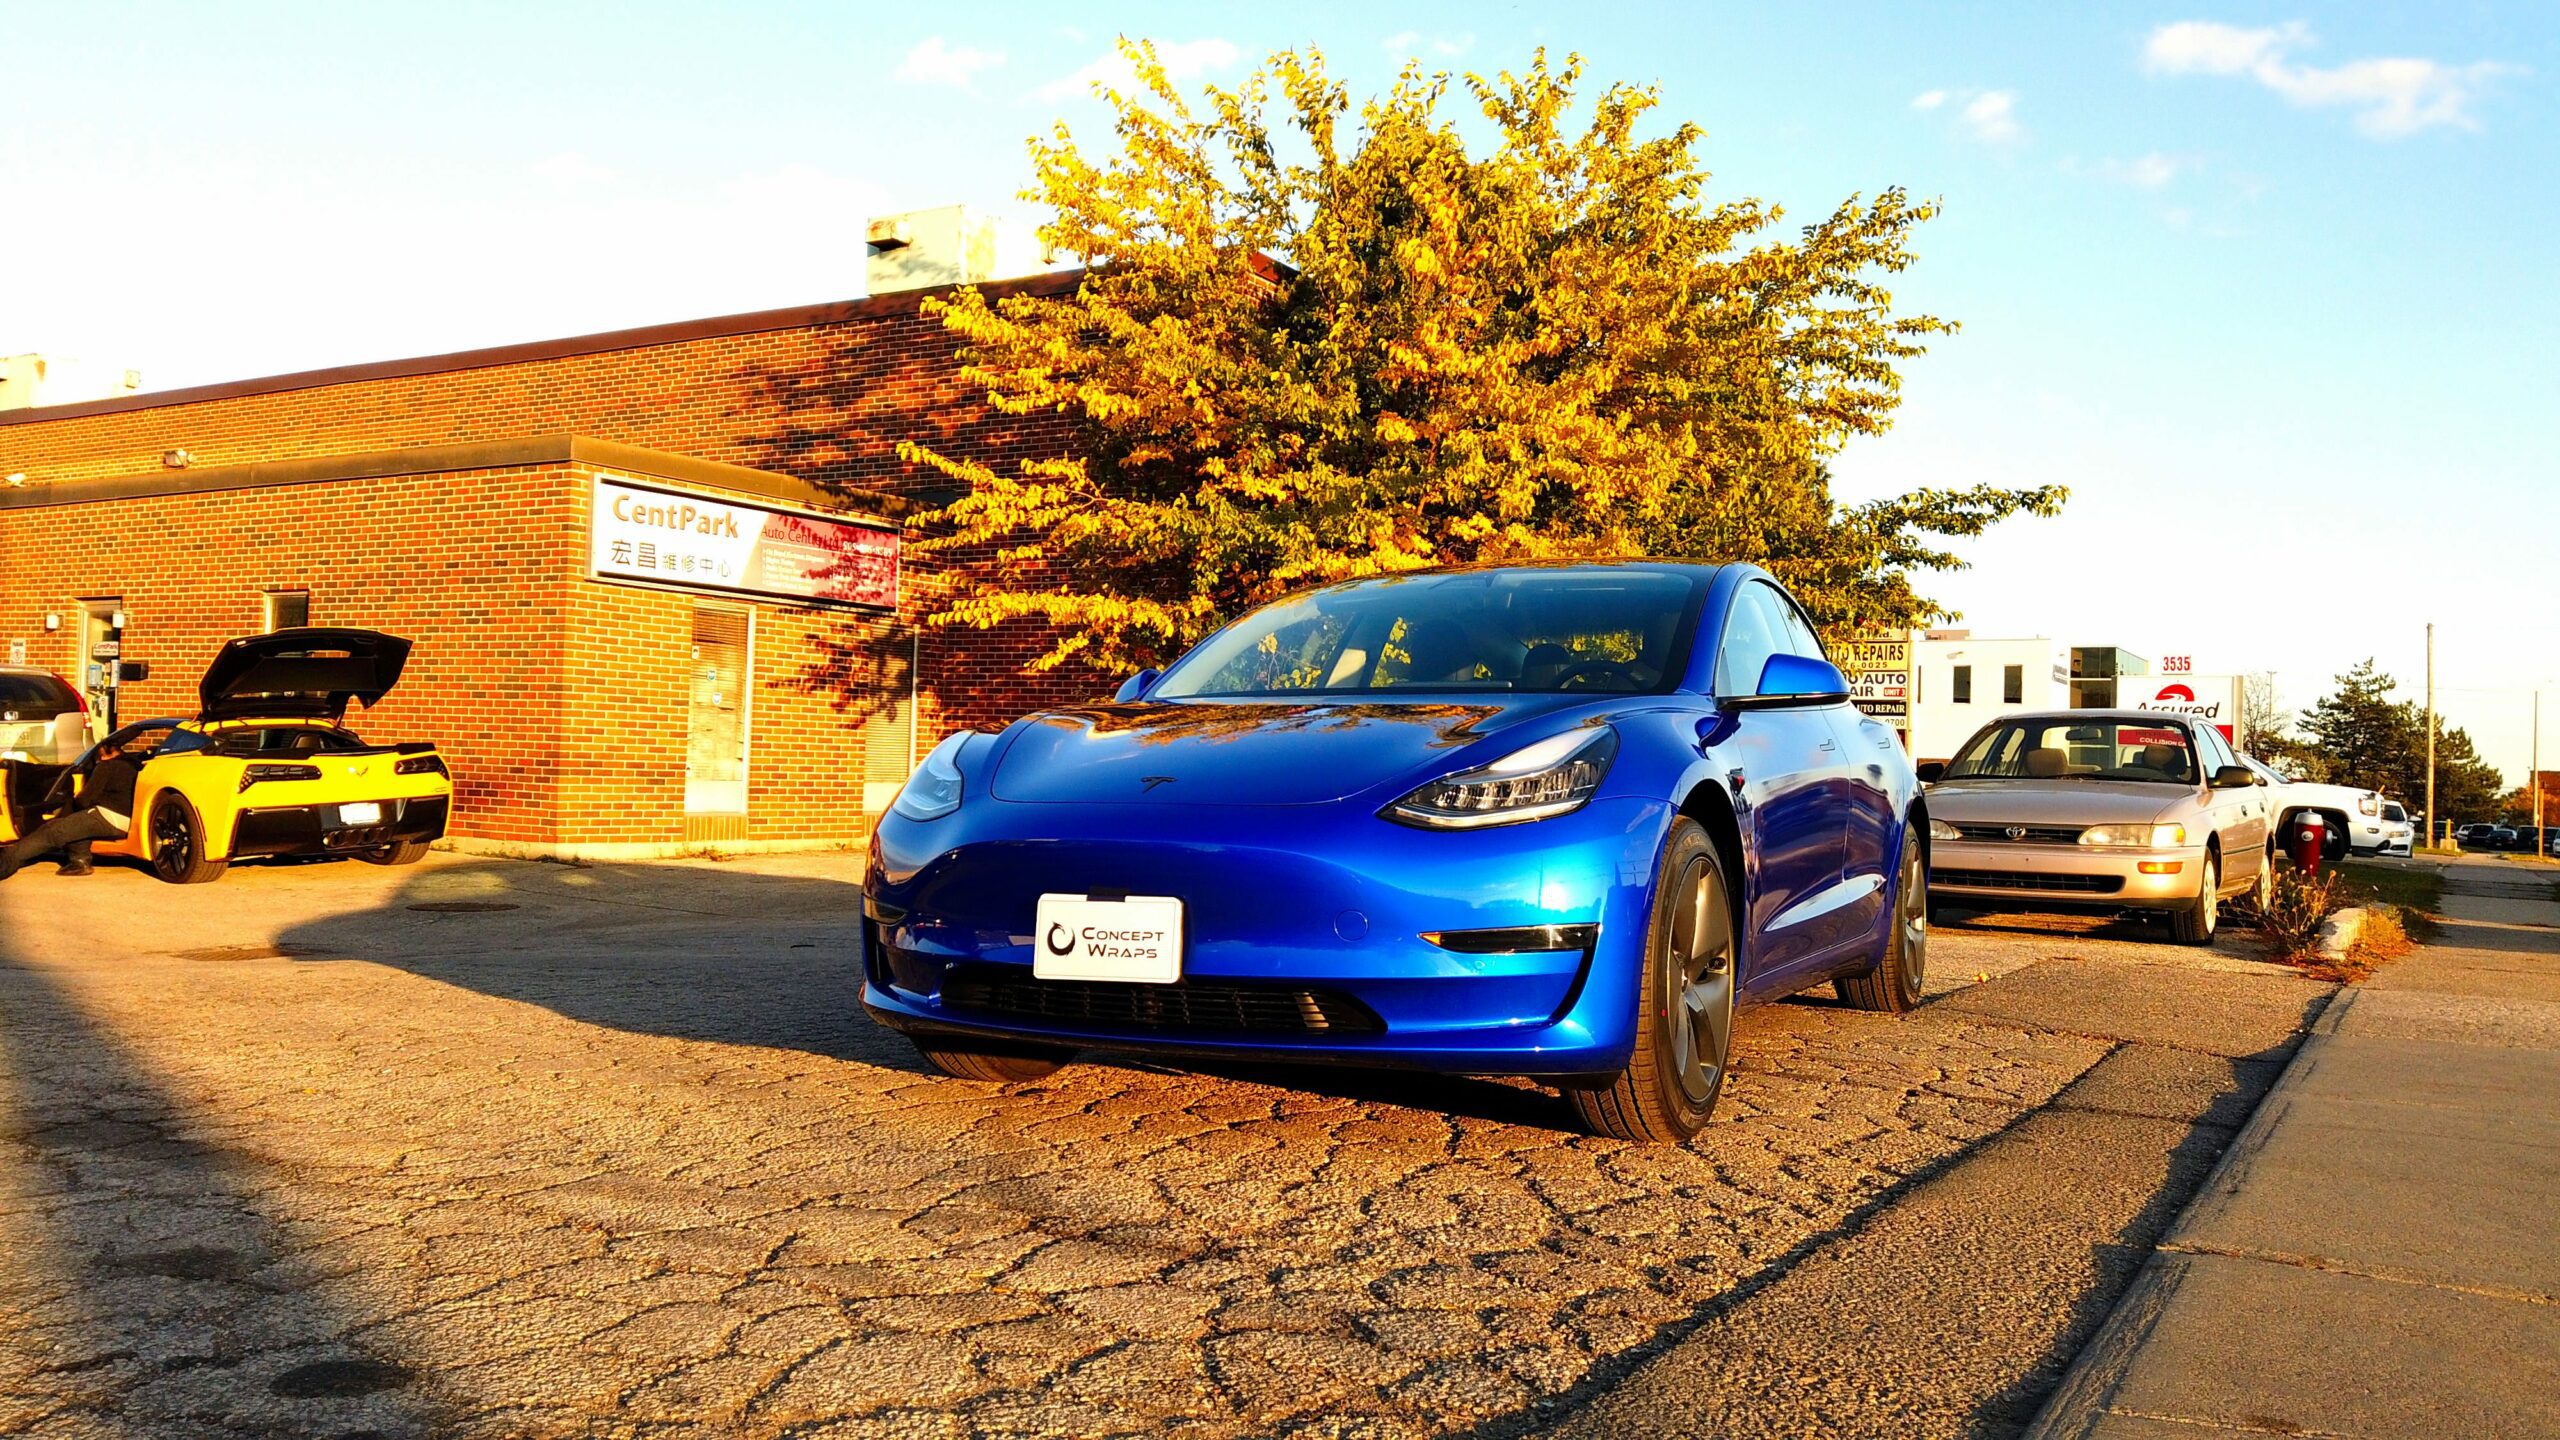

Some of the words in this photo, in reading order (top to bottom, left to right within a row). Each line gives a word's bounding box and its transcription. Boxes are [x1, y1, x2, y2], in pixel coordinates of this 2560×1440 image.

[612, 494, 739, 539] CentPark
[761, 525, 785, 540] Auto
[1854, 645, 1904, 661] REPAIRS
[2163, 656, 2191, 671] 3535
[1863, 674, 1906, 684] AUTO
[1884, 688, 1900, 697] UNIT
[1857, 704, 1875, 713] UTO
[1875, 704, 1905, 713] REPAIR
[2139, 737, 2177, 745] COLLISION
